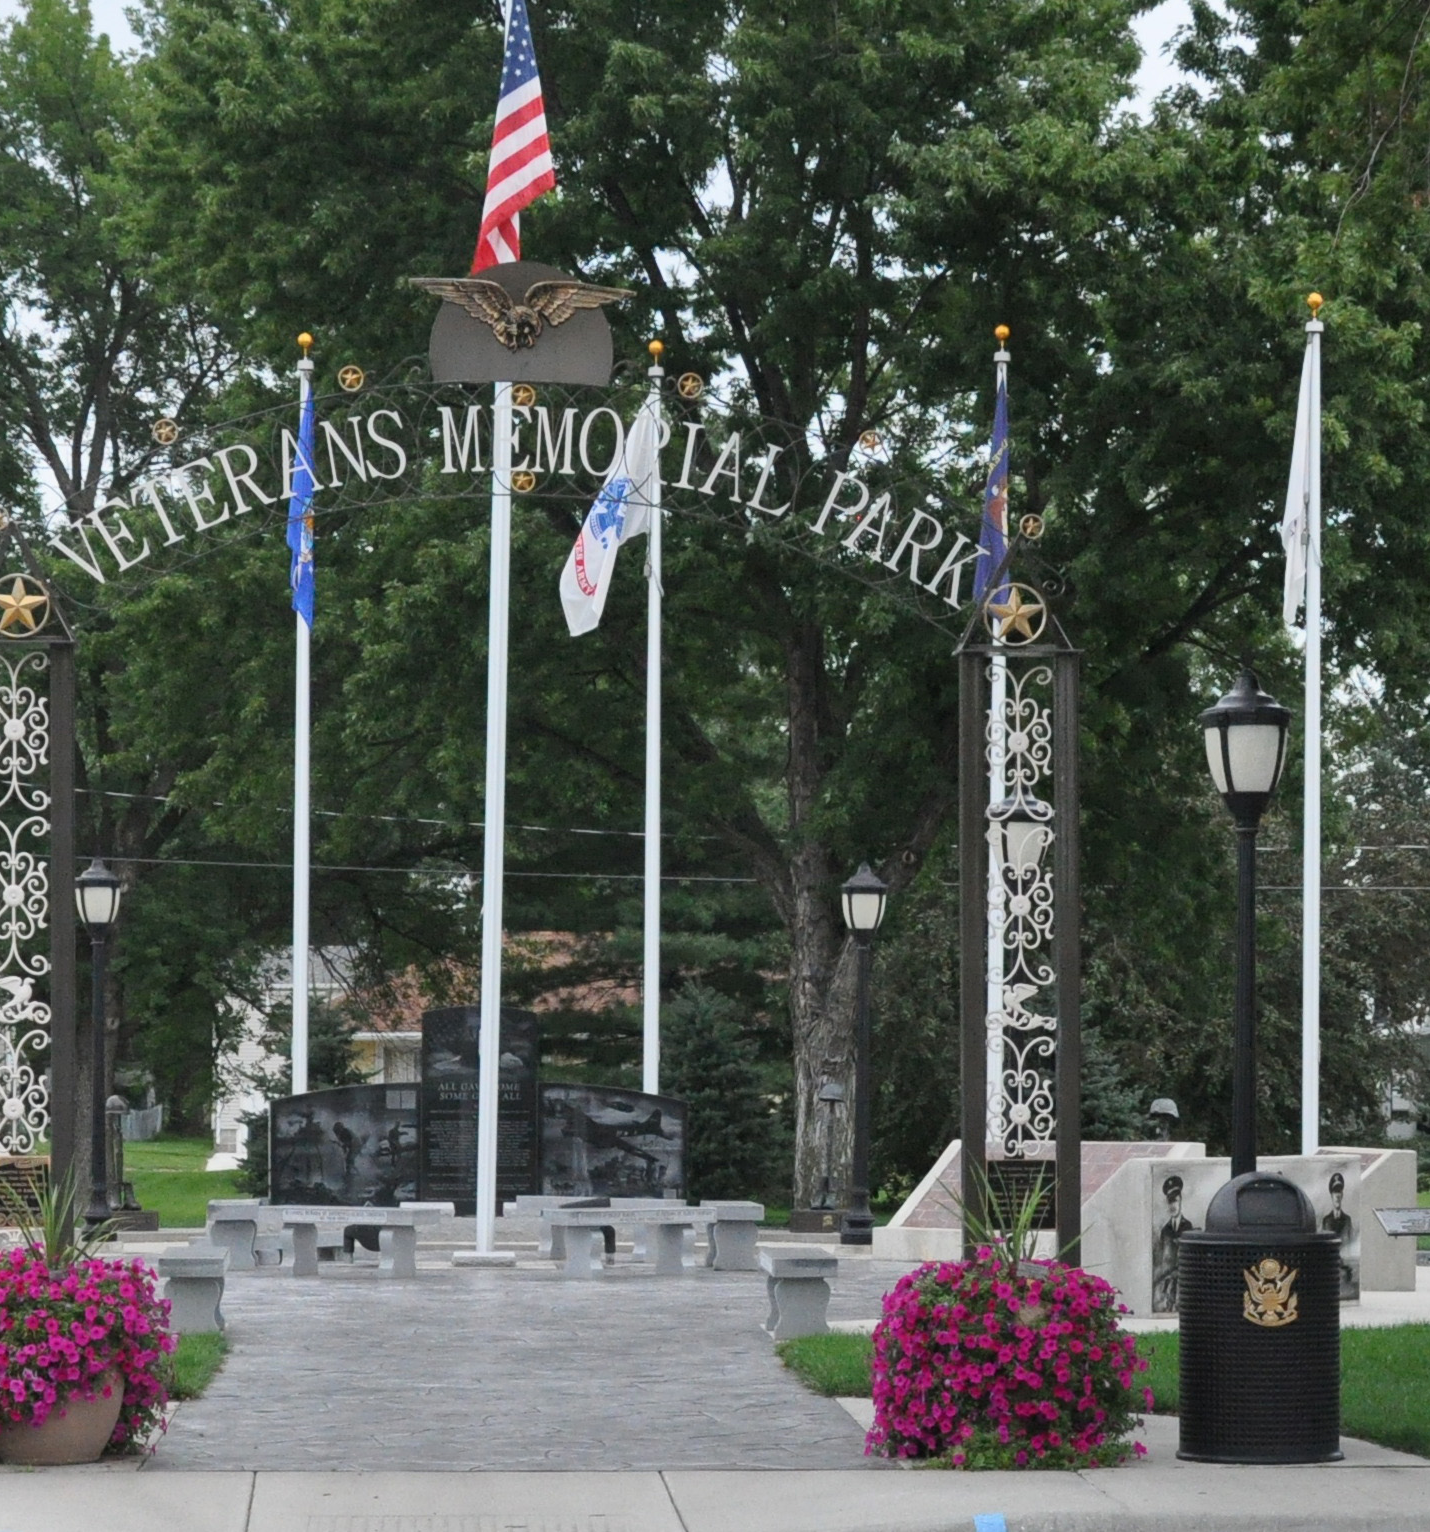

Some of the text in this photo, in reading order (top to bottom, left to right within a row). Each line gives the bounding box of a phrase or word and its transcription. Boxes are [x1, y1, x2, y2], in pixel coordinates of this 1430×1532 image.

[50, 405, 989, 610] VETERANS MEMORIAL PARK
